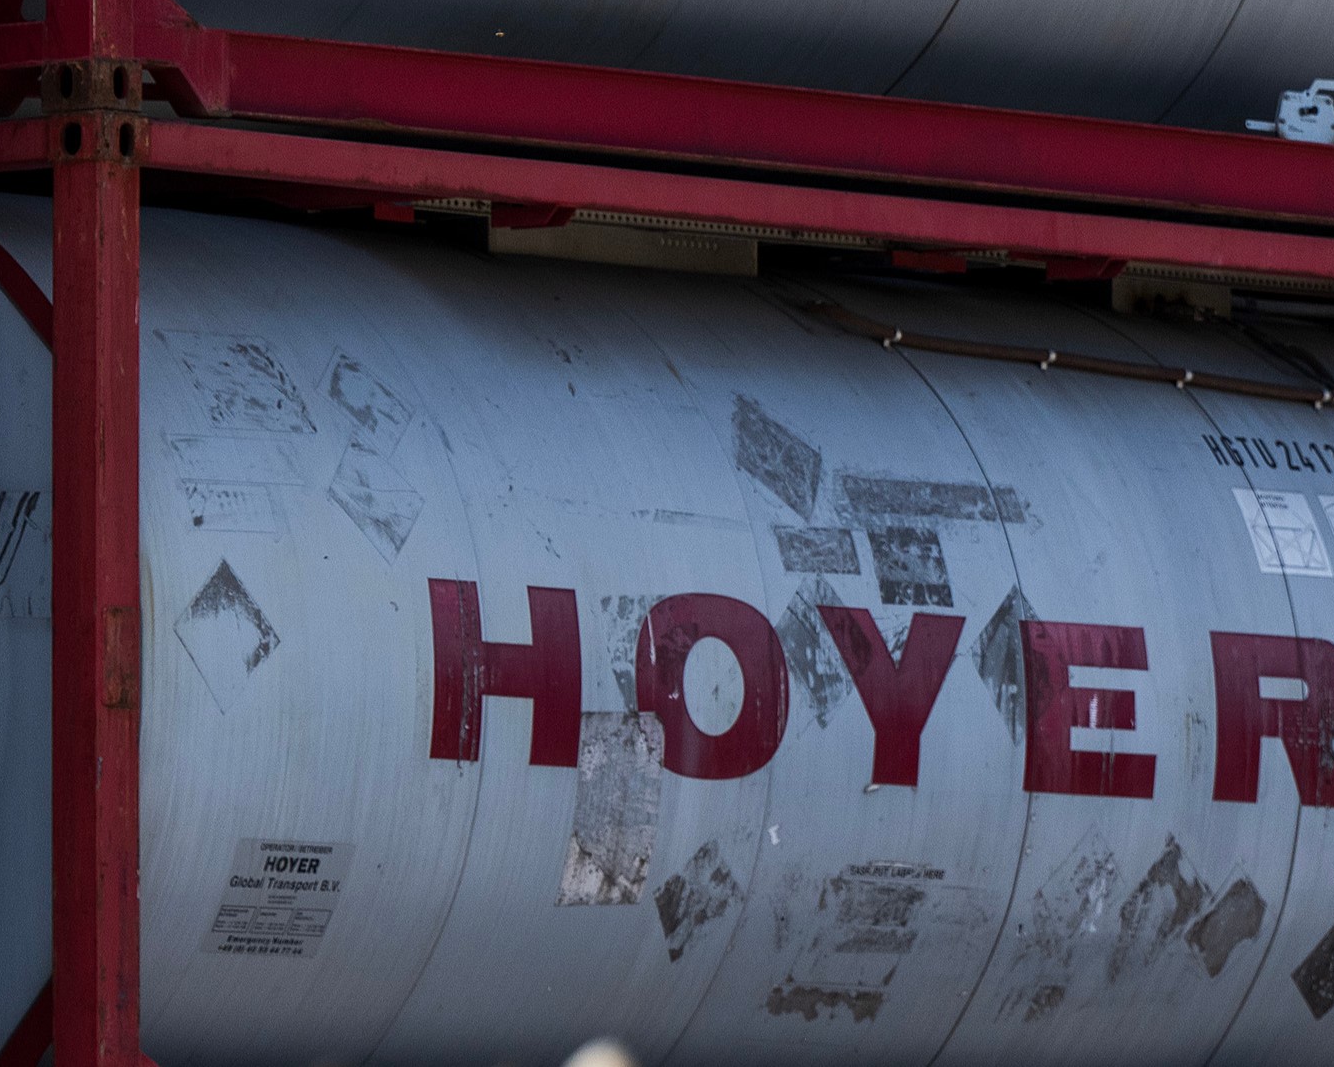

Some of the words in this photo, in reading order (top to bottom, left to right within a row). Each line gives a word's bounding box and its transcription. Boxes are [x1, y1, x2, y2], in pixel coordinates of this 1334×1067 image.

[1202, 434, 1276, 469] HGTU
[264, 856, 320, 874] HOYER
[230, 875, 264, 889] Global
[268, 877, 317, 893] Transport
